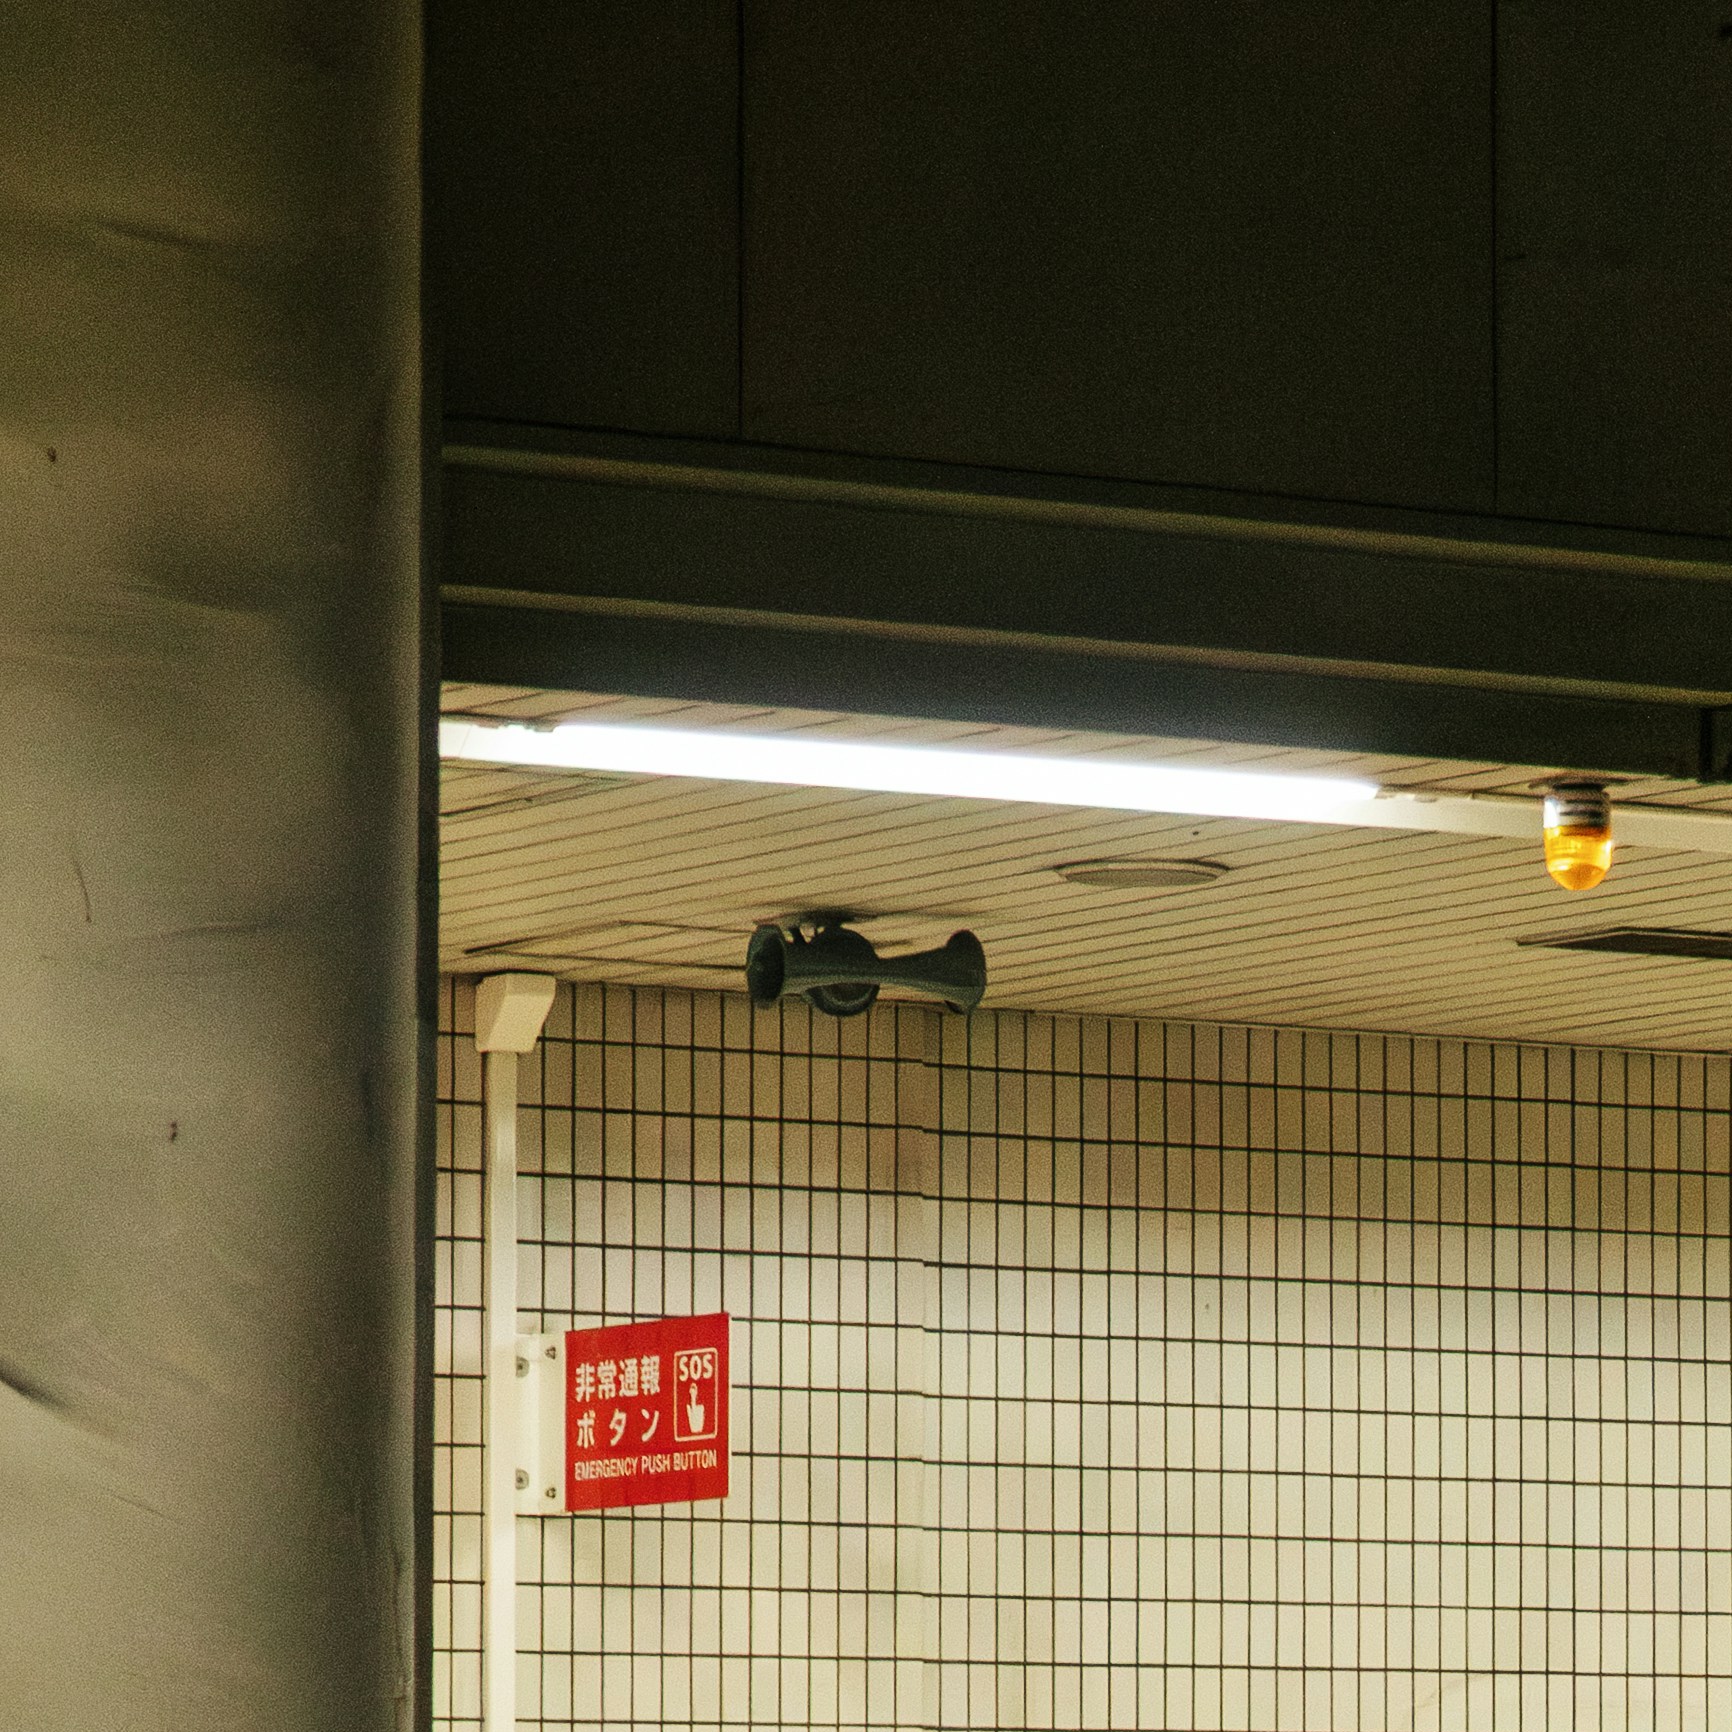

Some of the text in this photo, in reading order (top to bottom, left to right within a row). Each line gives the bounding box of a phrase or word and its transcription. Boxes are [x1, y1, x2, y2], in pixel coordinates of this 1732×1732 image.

[575, 1354, 661, 1403] 非常通報
[679, 1354, 713, 1382] SOS
[576, 1408, 660, 1449] ボタン
[574, 1449, 717, 1481] EMERGENCY PUSH BUTTON
